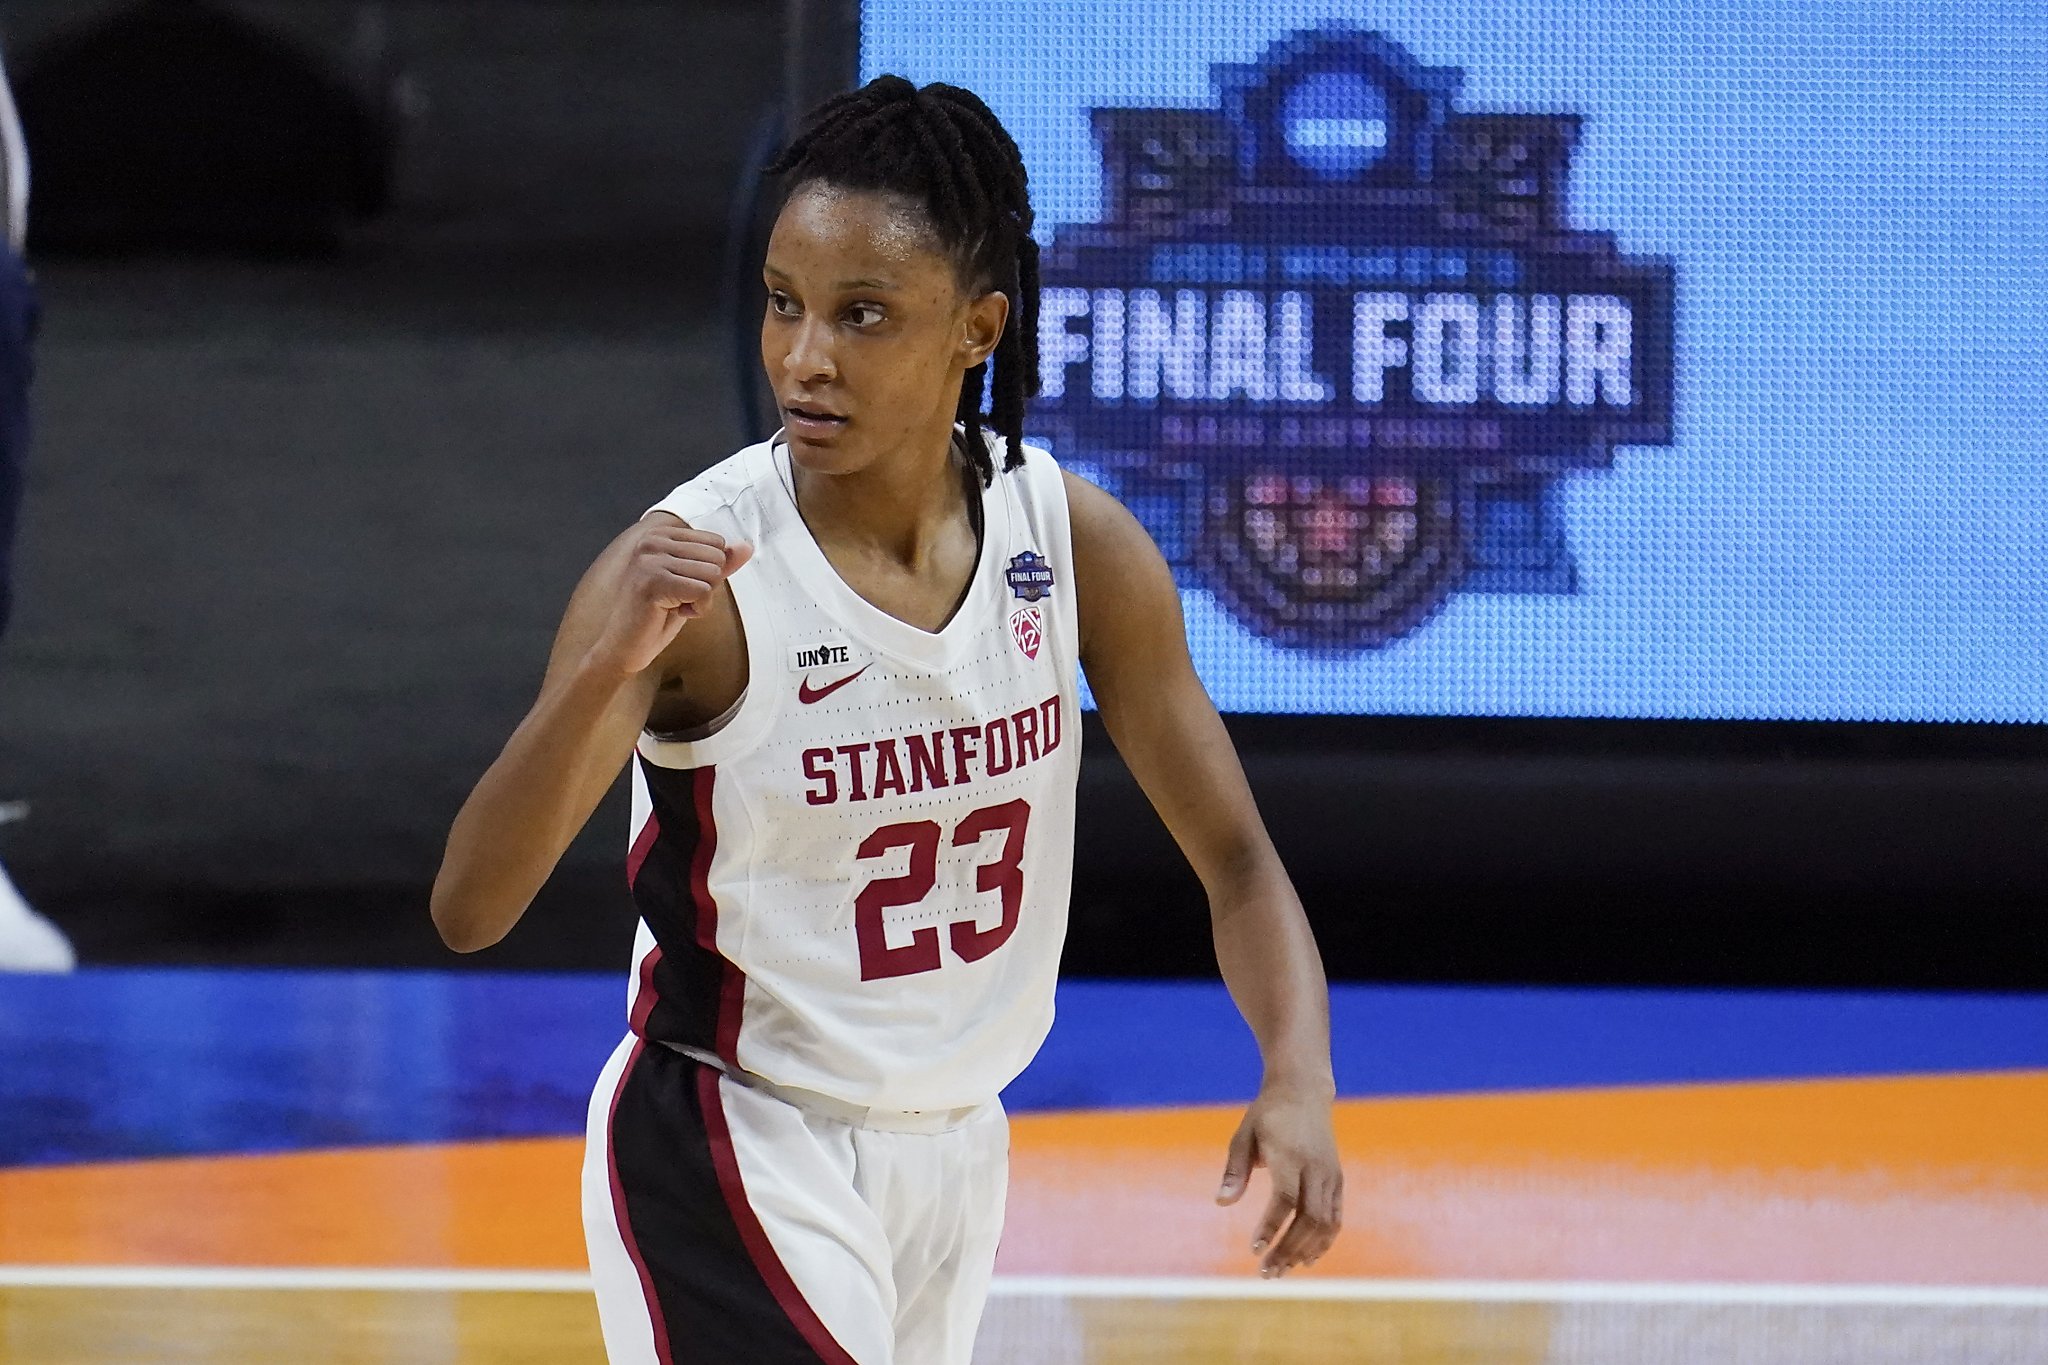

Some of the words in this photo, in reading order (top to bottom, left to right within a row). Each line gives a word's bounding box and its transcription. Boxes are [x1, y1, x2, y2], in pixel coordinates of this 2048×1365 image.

[1038, 287, 1326, 402] FINAL
[1353, 291, 1633, 405] FOUR
[1011, 571, 1031, 582] FINAL
[1032, 571, 1051, 581] FOUR
[1020, 629, 1039, 653] 12
[801, 694, 1061, 806] STANFORD
[854, 797, 1031, 982] 23
